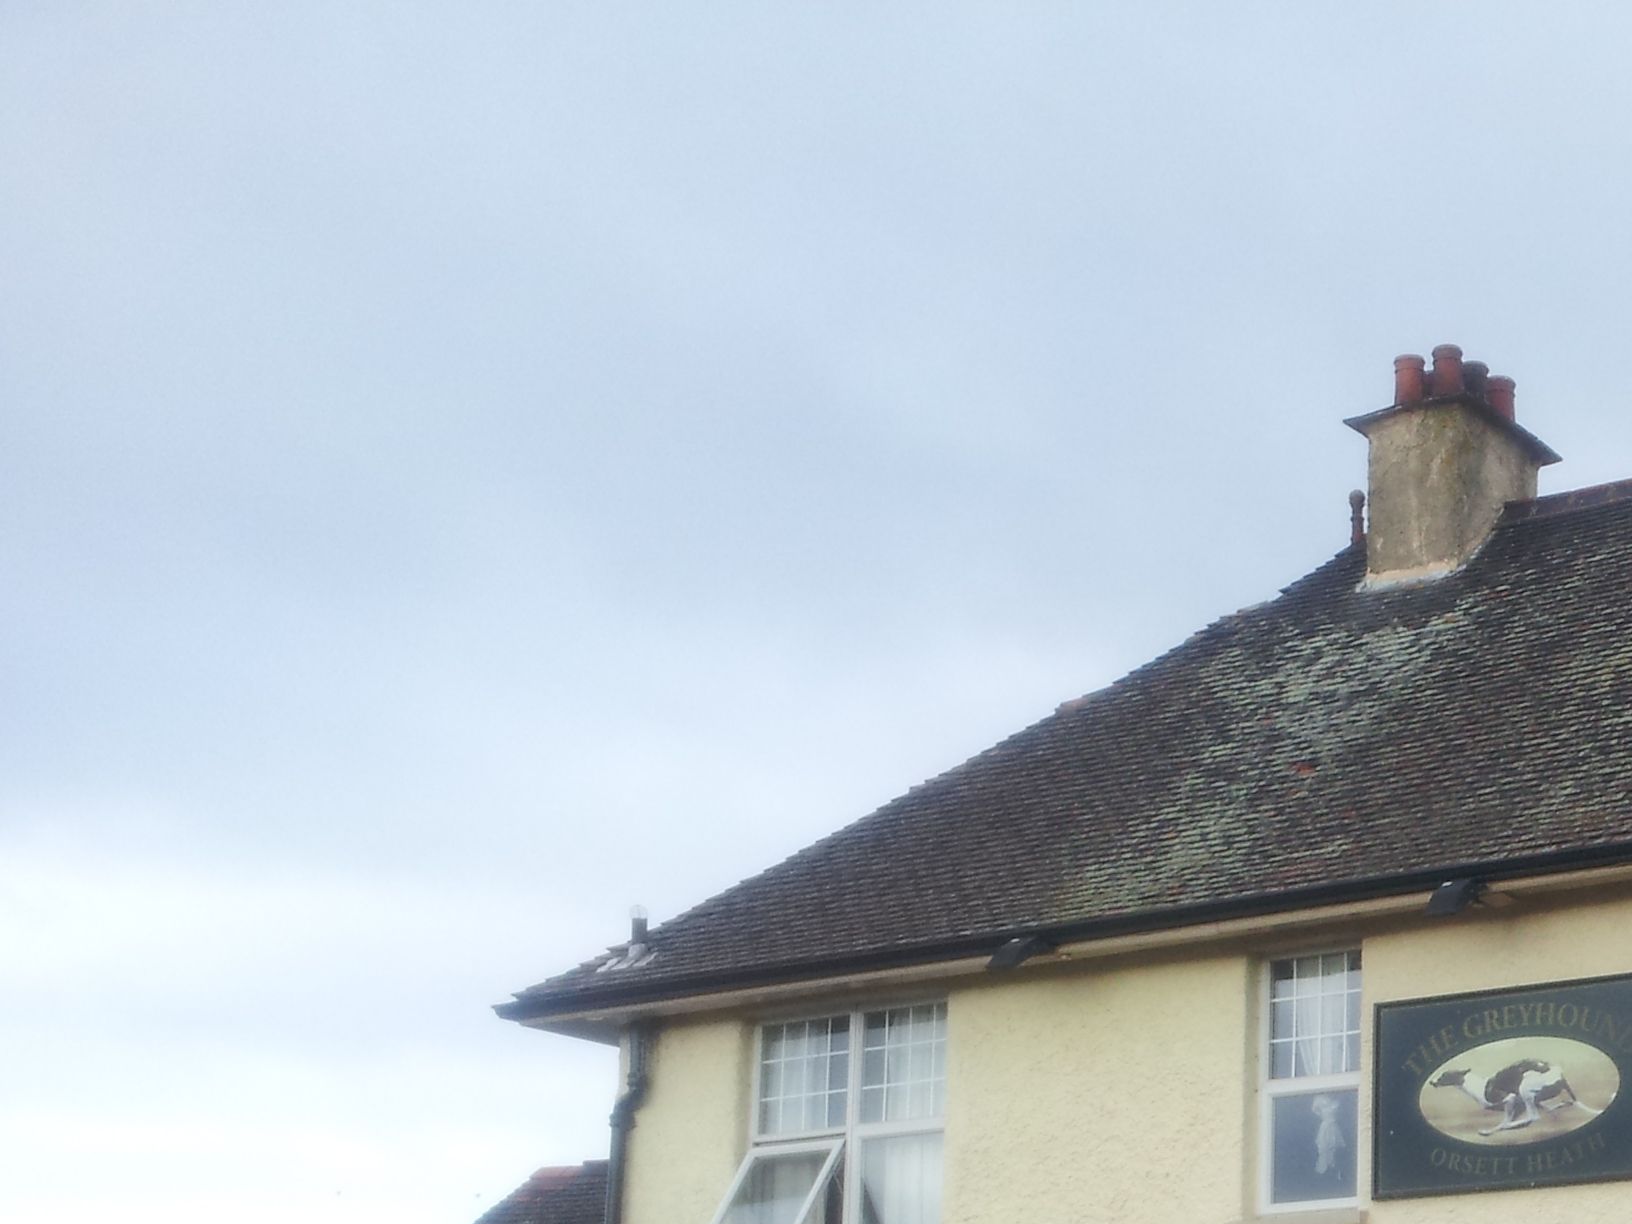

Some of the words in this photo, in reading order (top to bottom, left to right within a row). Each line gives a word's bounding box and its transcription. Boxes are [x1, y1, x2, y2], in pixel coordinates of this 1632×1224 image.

[1402, 1024, 1460, 1075] THE
[1430, 1148, 1518, 1175] ORSETT
[1527, 1133, 1606, 1174] HEATH
